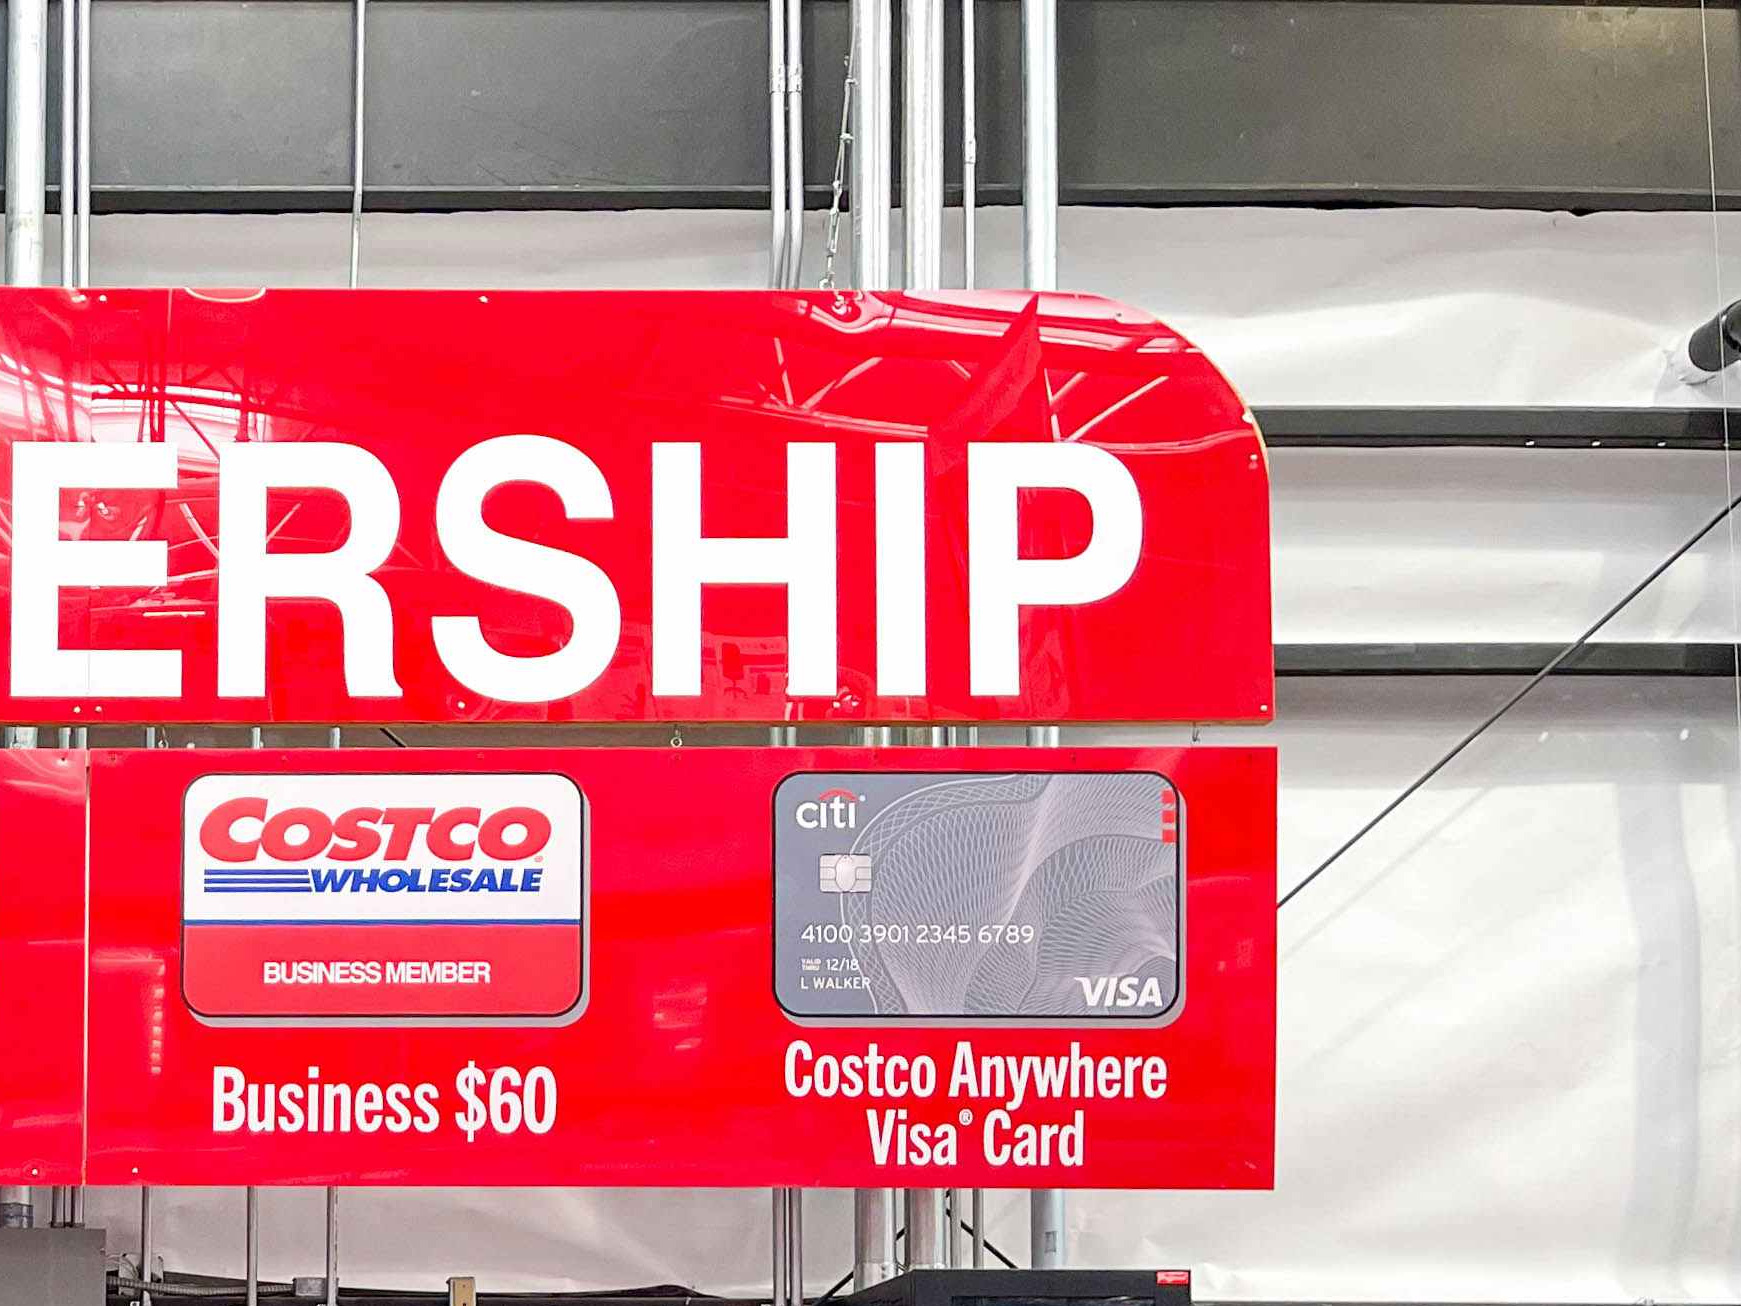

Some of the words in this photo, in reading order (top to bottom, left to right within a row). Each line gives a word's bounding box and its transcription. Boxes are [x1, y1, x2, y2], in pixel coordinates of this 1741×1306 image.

[795, 796, 857, 829] citi
[199, 797, 552, 862] COSTCO
[310, 868, 543, 893] WHOLESALE
[800, 924, 853, 944] 4100
[859, 924, 909, 944] 3901
[916, 924, 971, 944] 2345
[978, 924, 1035, 944] 6789
[263, 961, 382, 984] BUSINESS
[385, 961, 491, 985] MEMBER
[826, 958, 859, 972] 12/18
[800, 977, 808, 989] L
[813, 977, 872, 990] WALKER
[1074, 976, 1164, 1008] VISA
[784, 1039, 937, 1099] Costco
[948, 1040, 1168, 1111] Anywhere
[212, 1065, 440, 1134] Business
[455, 1060, 558, 1143] $60
[983, 1109, 1085, 1167] Card
